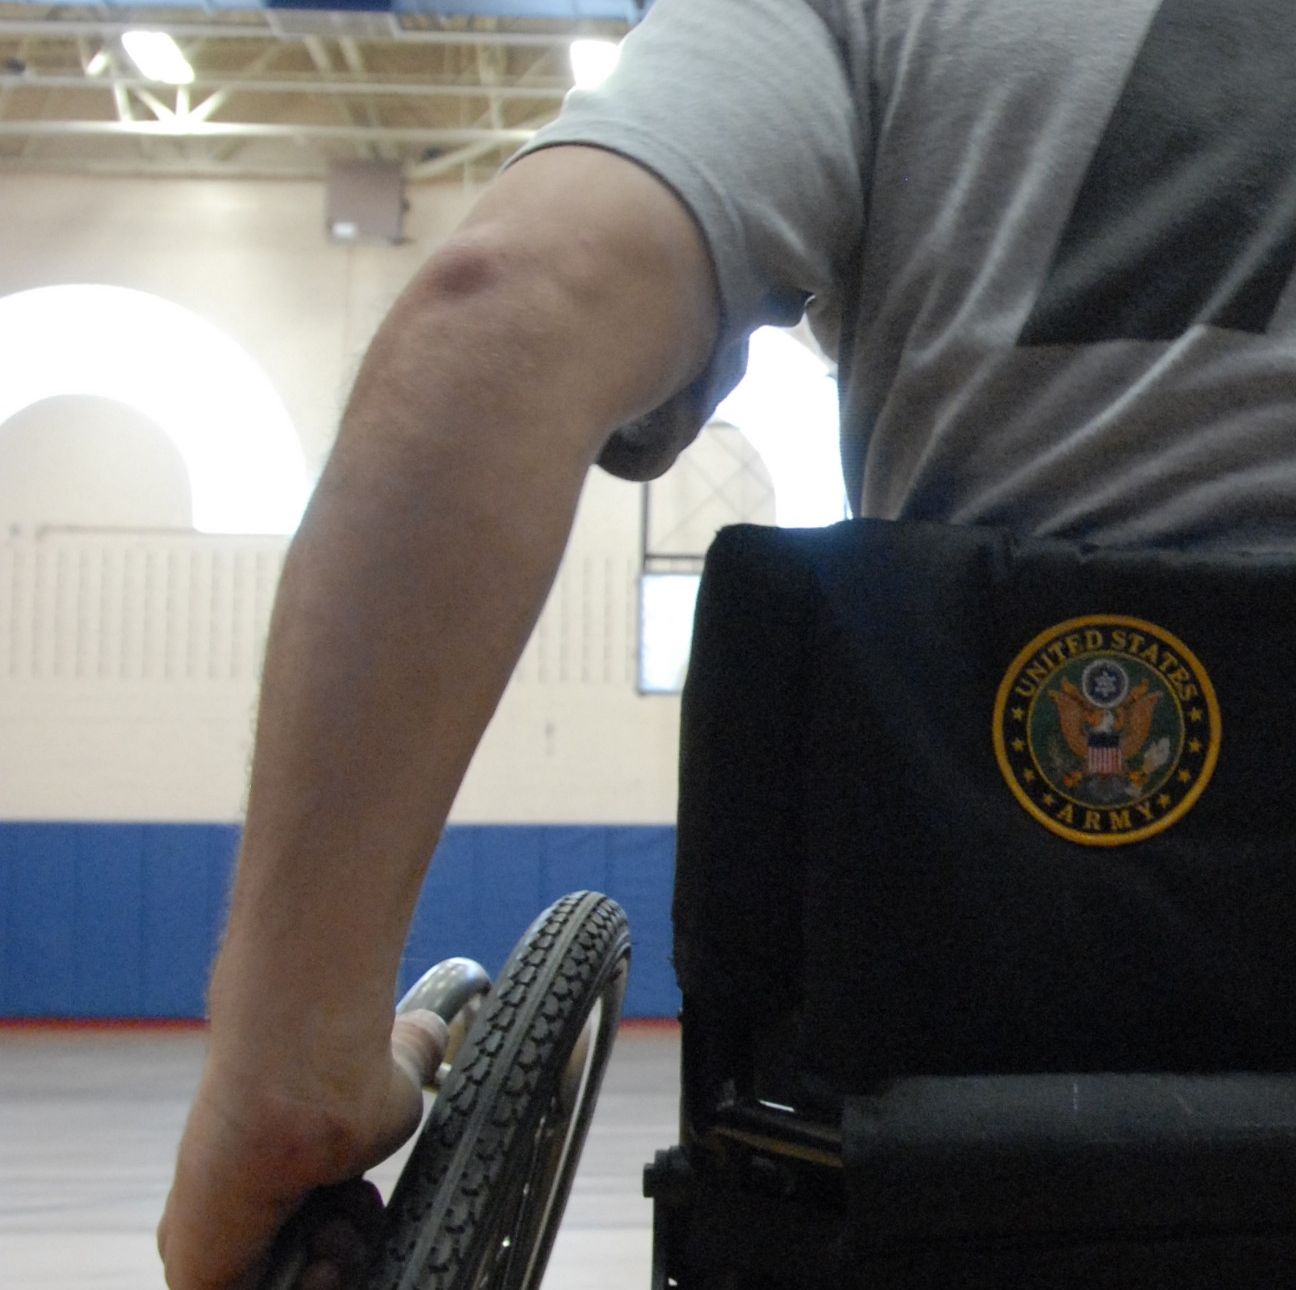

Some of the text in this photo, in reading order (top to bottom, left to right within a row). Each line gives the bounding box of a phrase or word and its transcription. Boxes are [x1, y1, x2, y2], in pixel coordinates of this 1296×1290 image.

[1015, 630, 1199, 701] UNITED STATES
[1056, 804, 1155, 831] ARMY
